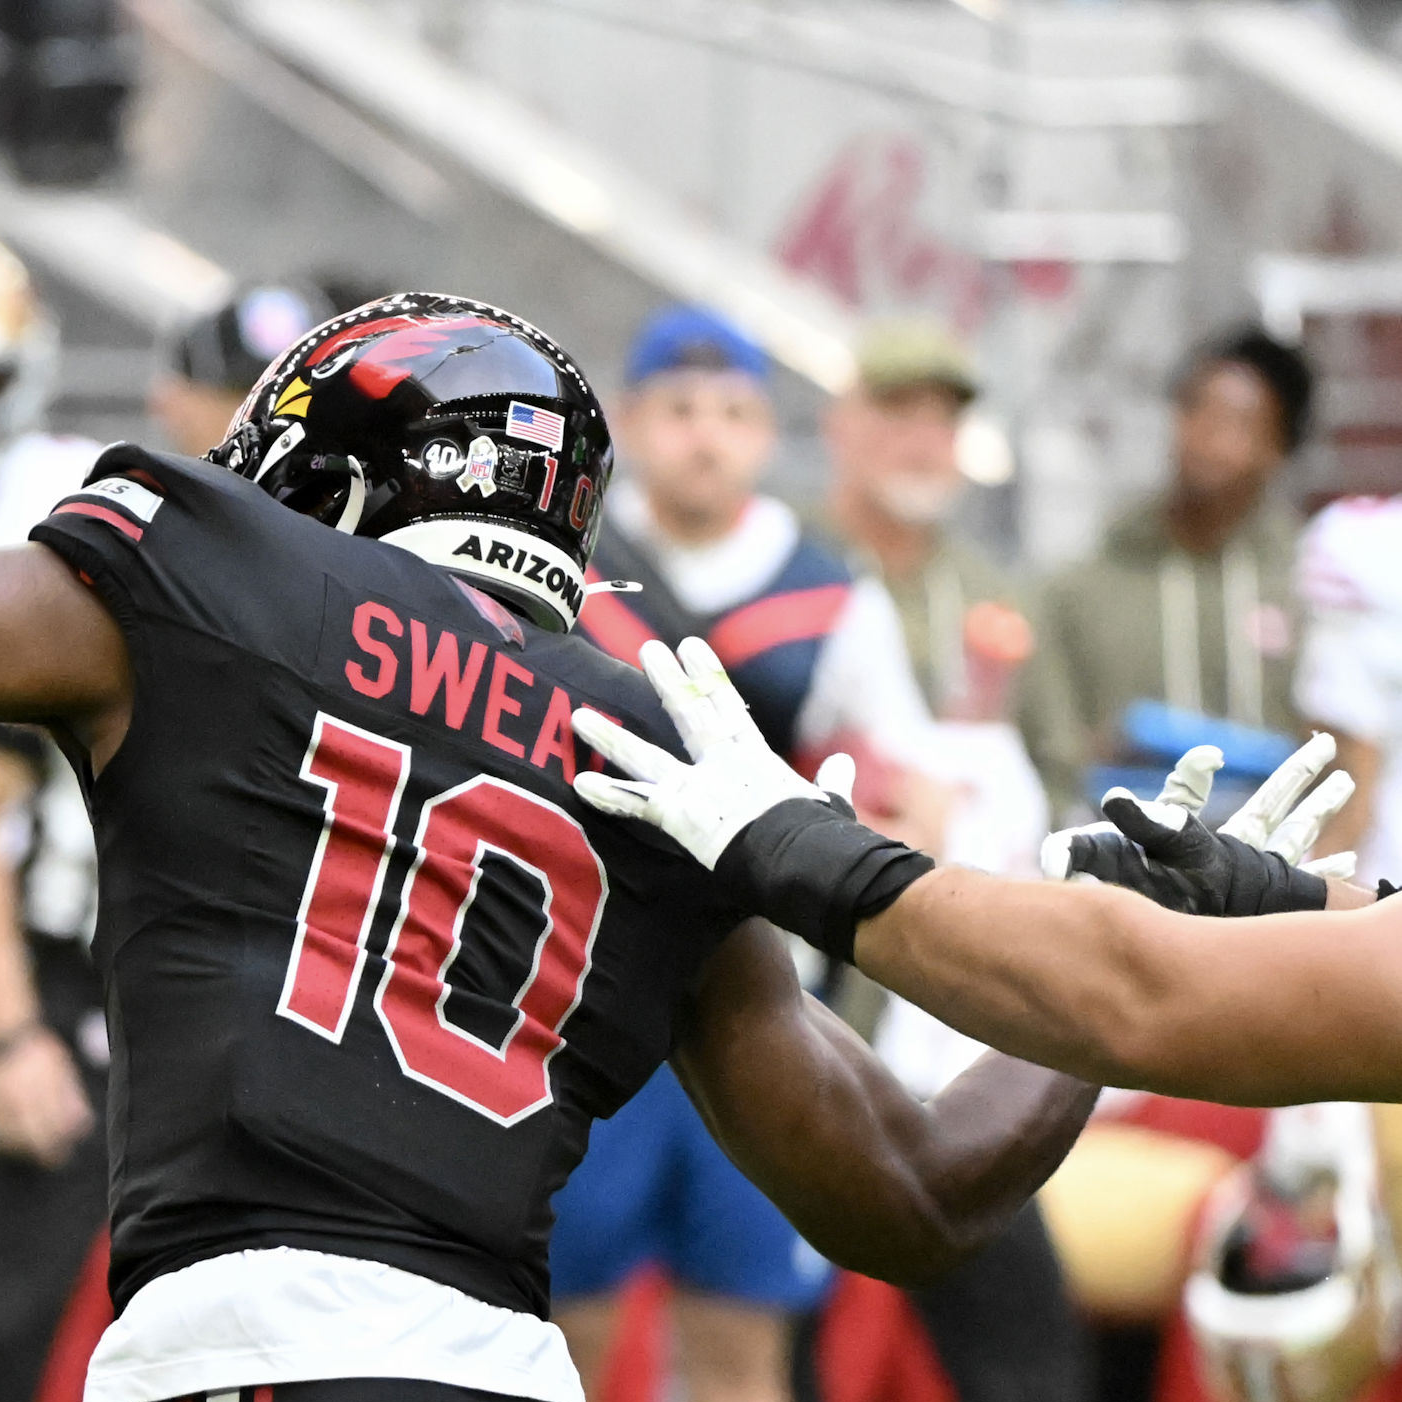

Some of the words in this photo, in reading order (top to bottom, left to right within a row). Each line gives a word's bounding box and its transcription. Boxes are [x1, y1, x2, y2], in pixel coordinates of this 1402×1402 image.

[424, 443, 461, 475] 40
[470, 462, 491, 479] NFL
[276, 710, 610, 1128] 10
